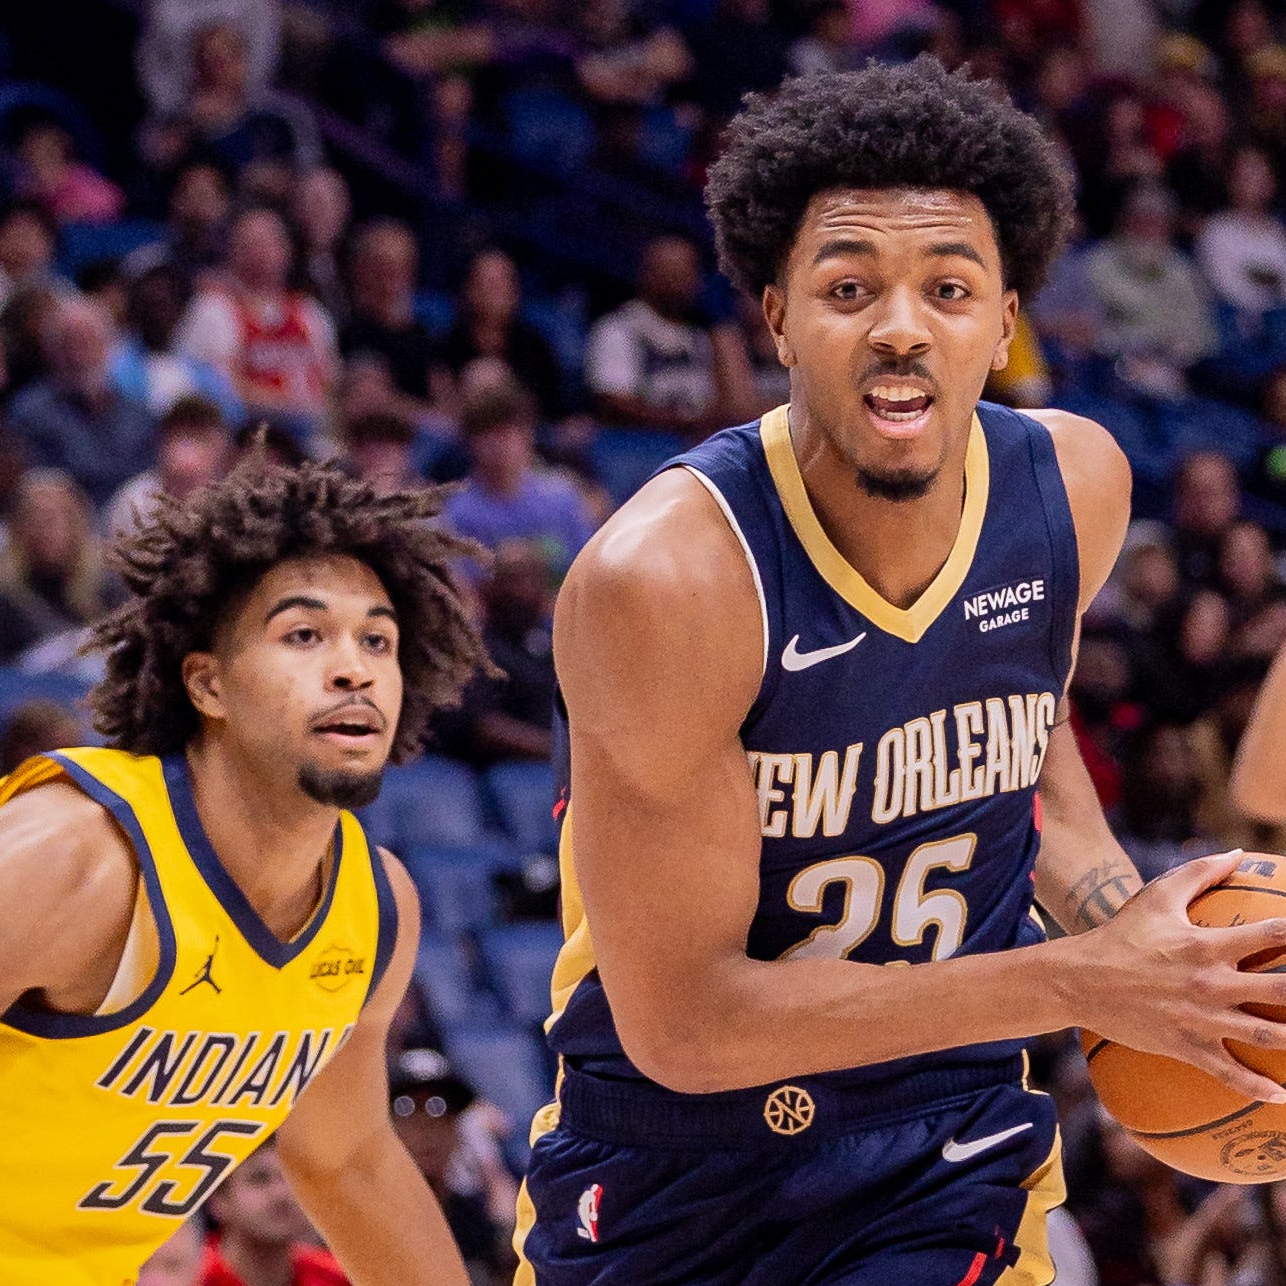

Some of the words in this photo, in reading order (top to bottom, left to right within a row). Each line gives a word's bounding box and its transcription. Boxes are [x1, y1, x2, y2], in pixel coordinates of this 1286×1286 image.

[963, 579, 1045, 621] NEWAGE
[978, 607, 1030, 633] GARAGE
[870, 691, 1056, 825] ORLEANS
[94, 1024, 356, 1111] INDIAN
[77, 1119, 268, 1220] 55
